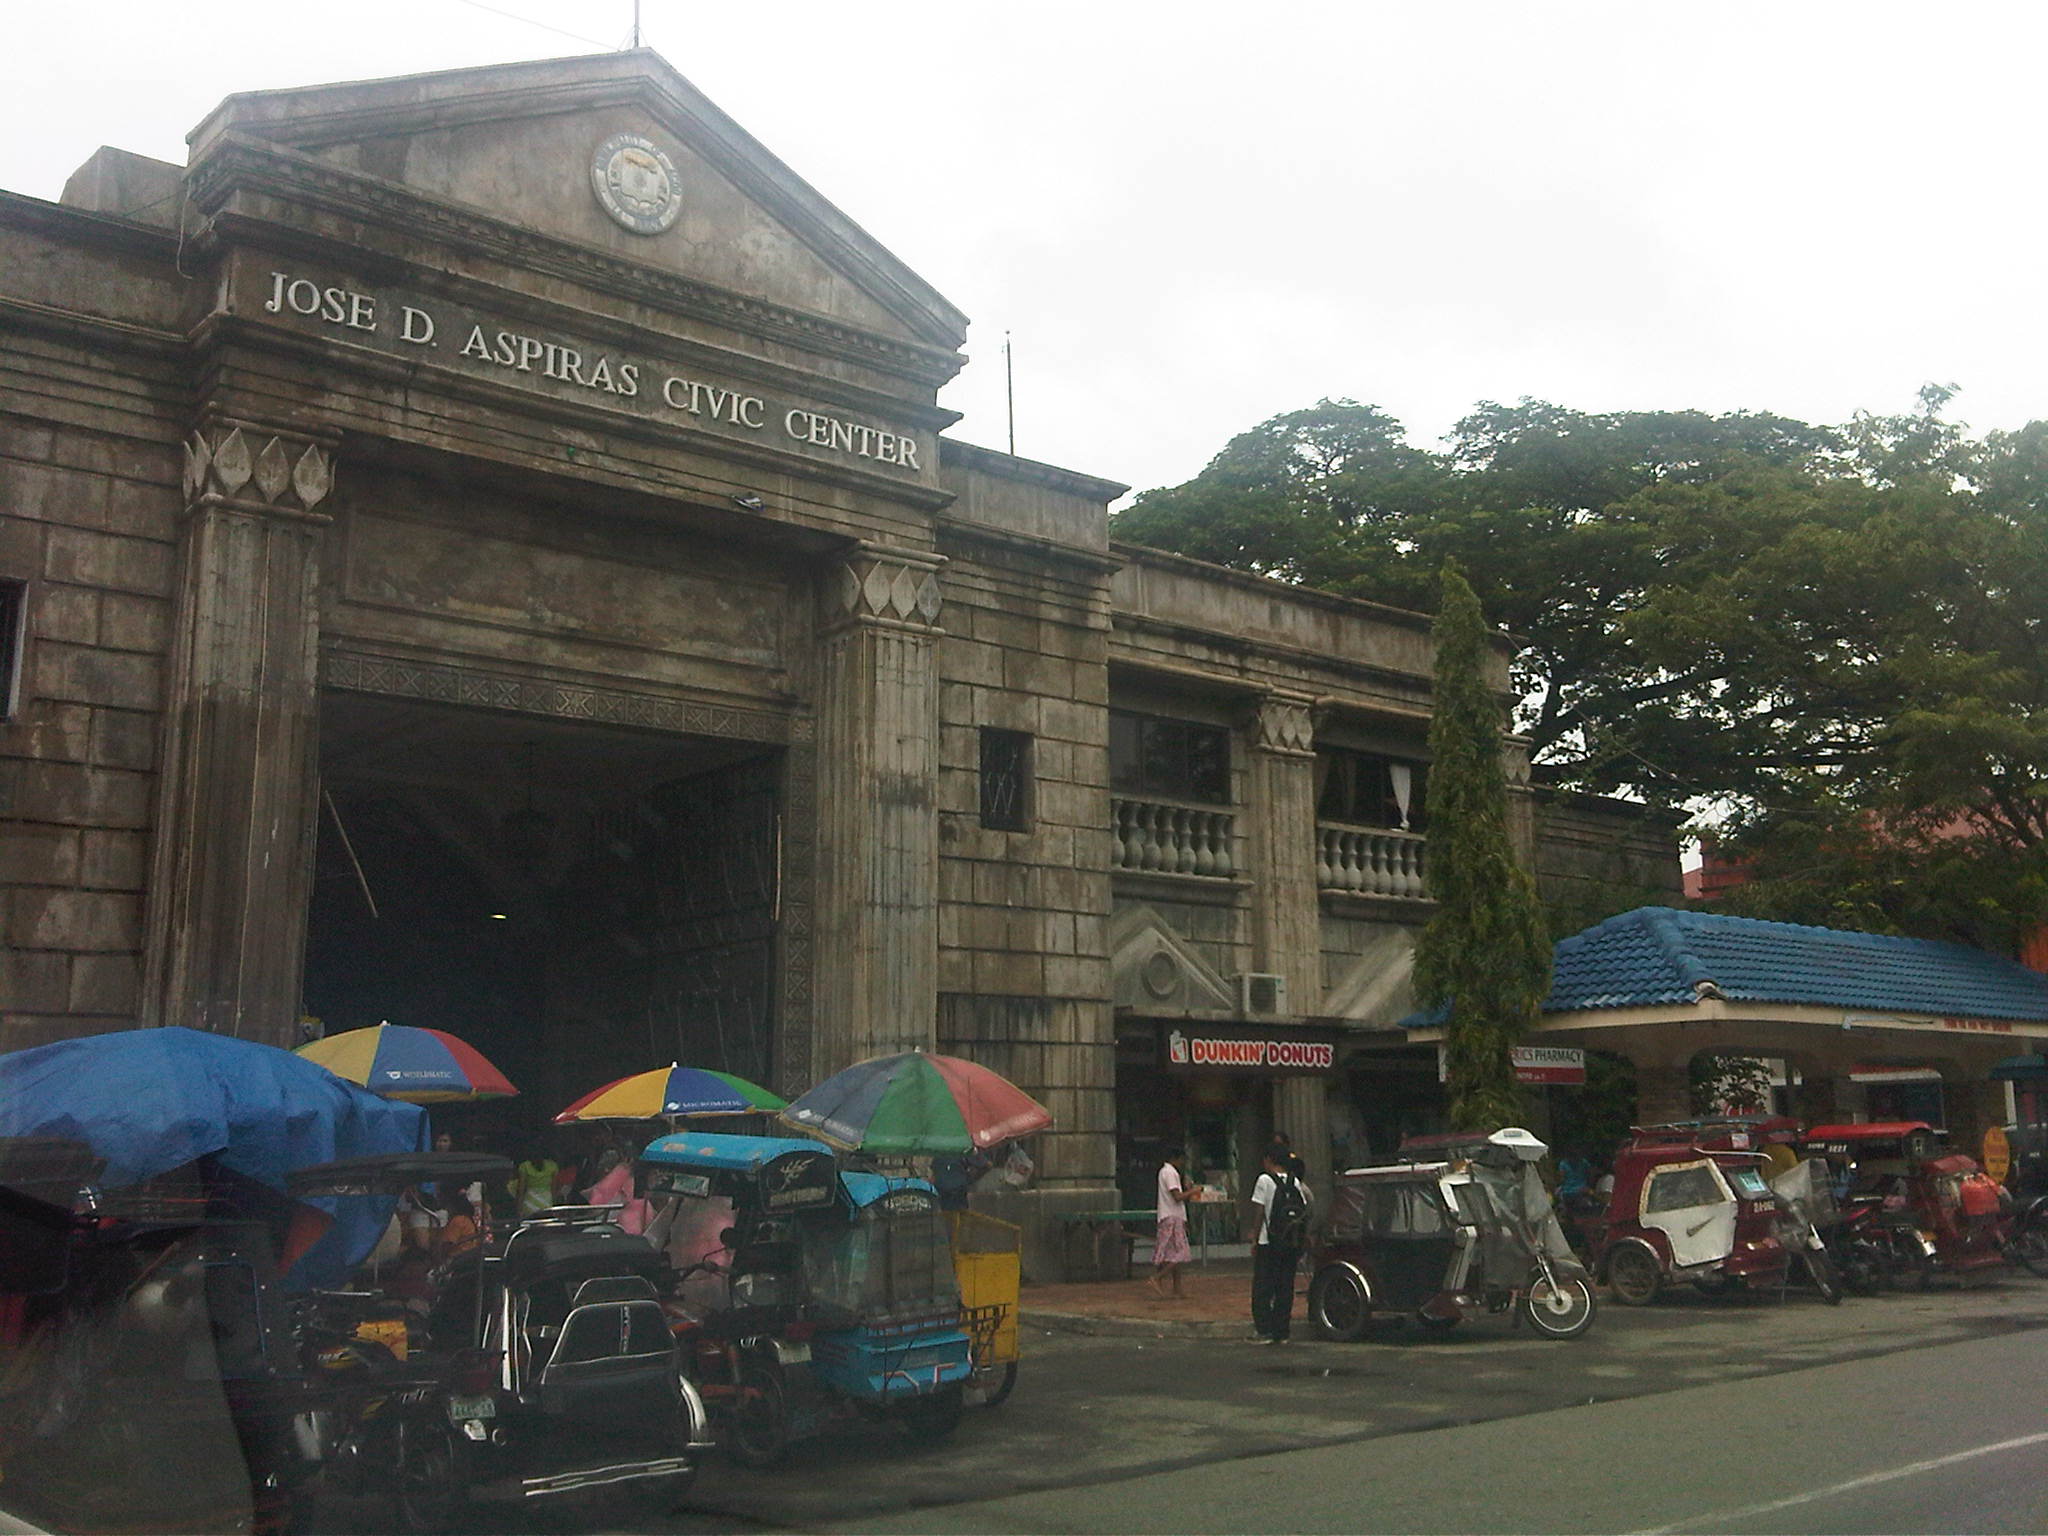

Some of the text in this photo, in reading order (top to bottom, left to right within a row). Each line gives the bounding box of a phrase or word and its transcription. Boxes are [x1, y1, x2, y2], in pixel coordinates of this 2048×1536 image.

[265, 272, 920, 470] JOSE D. ASPIRAS CIVIC CENTER
[1192, 1039, 1334, 1067] DUNKIN' DONUTS
[1534, 1048, 1582, 1063] PHARMACY
